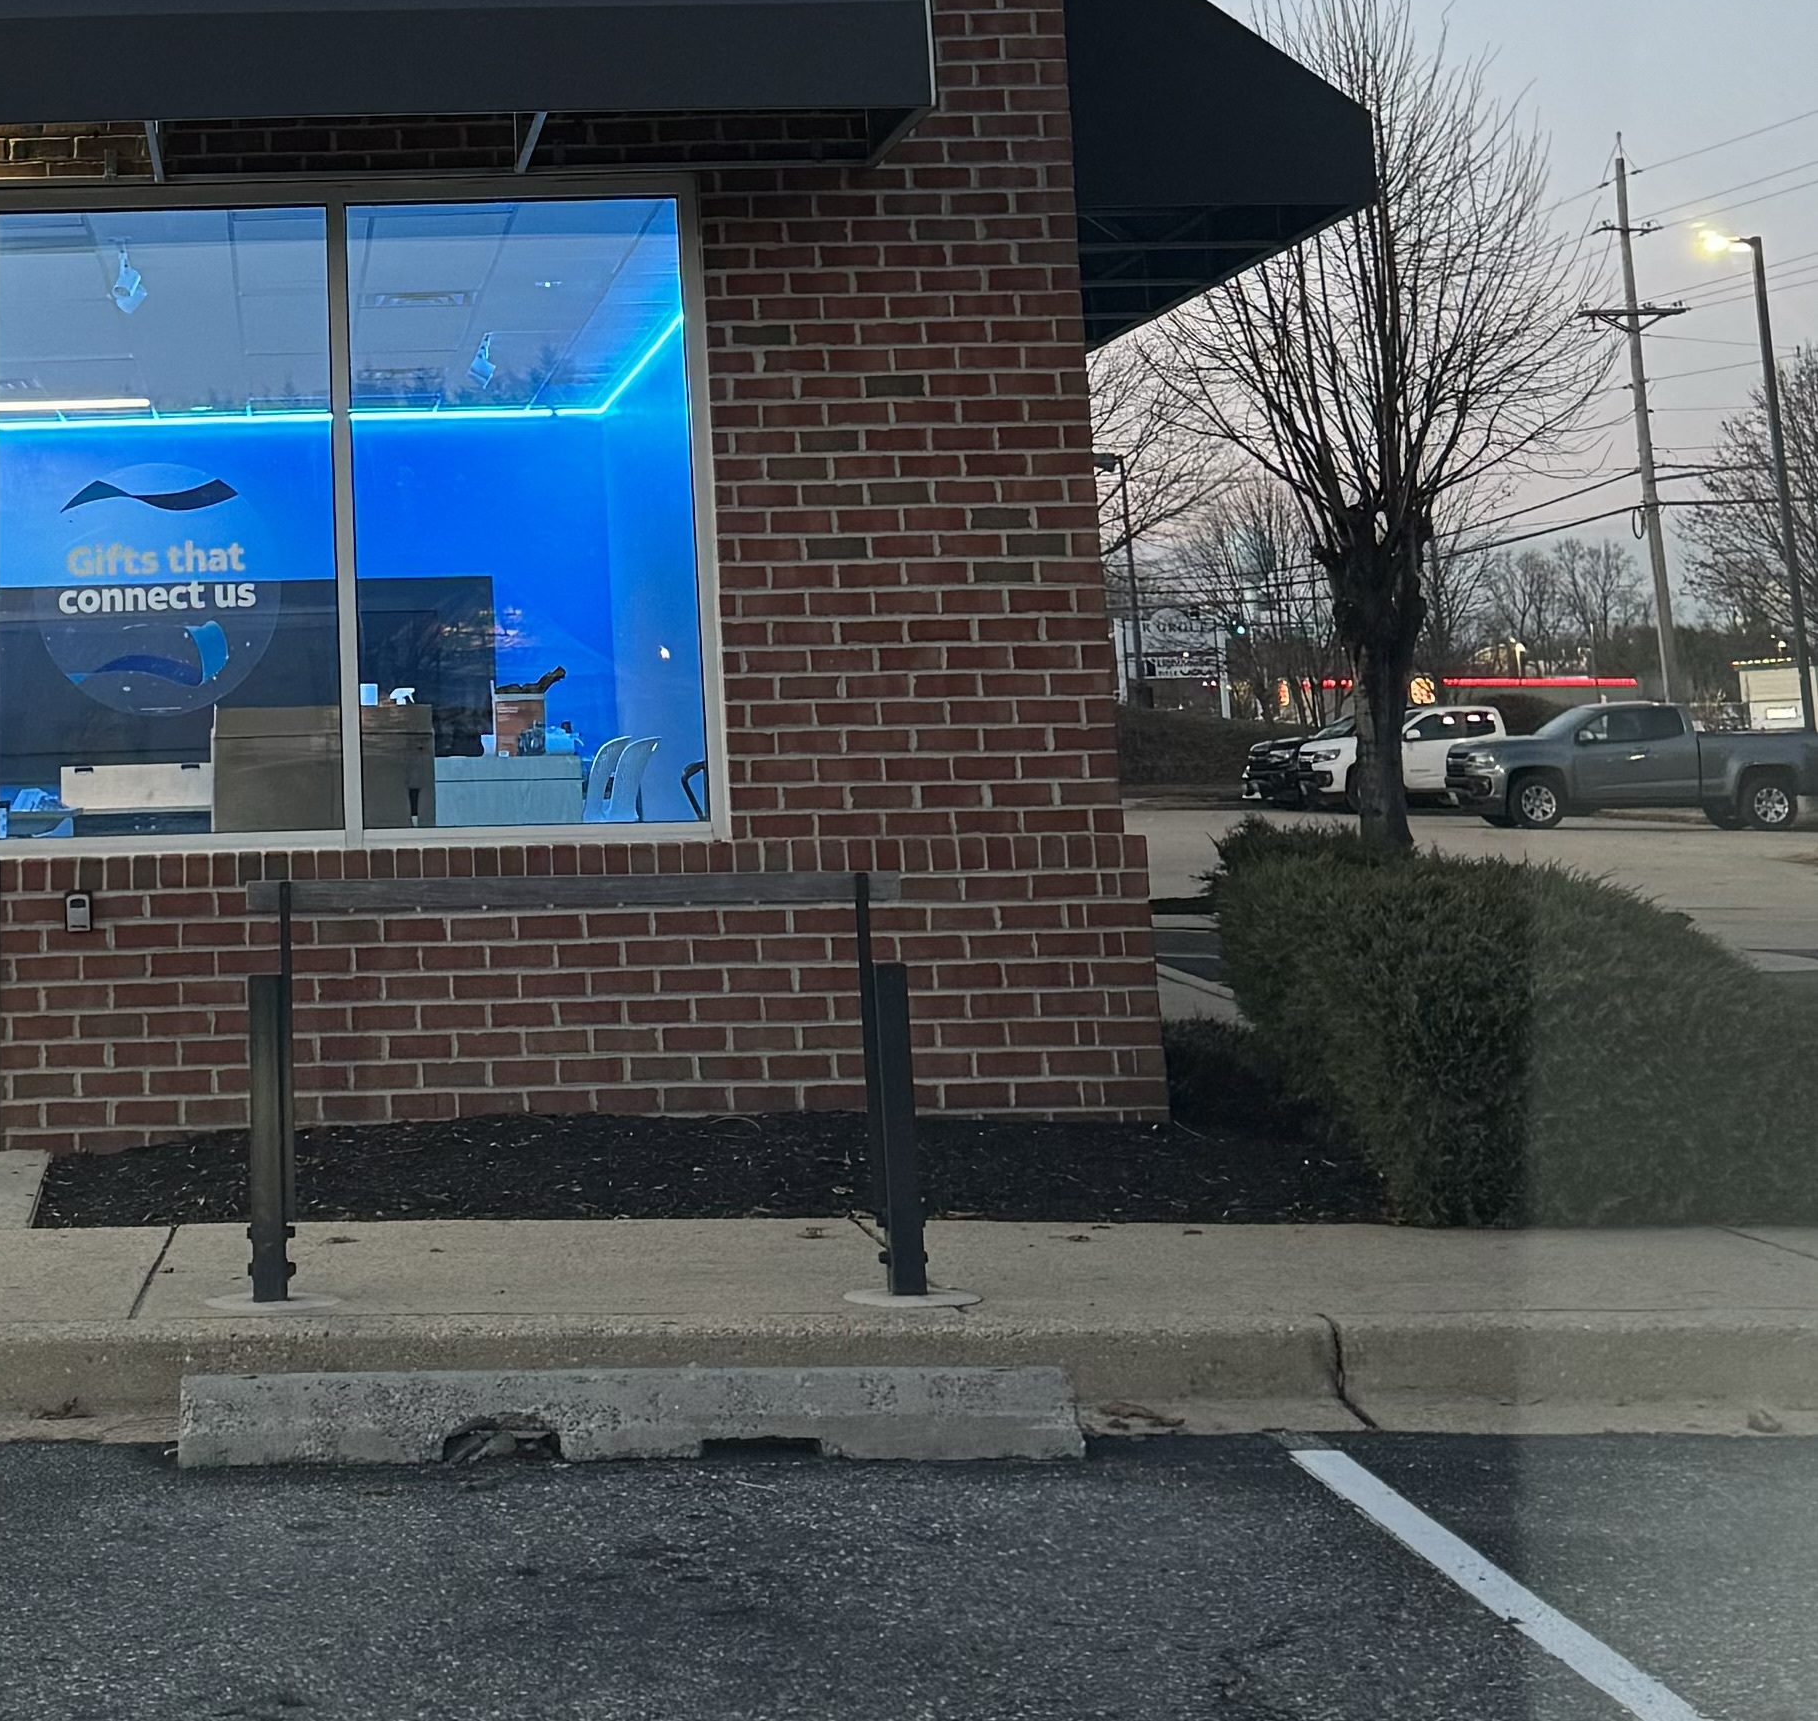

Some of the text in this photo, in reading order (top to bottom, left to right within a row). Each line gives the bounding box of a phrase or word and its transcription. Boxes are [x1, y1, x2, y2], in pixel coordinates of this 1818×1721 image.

[67, 539, 246, 577] Gifts that
[58, 581, 257, 614] connect us
